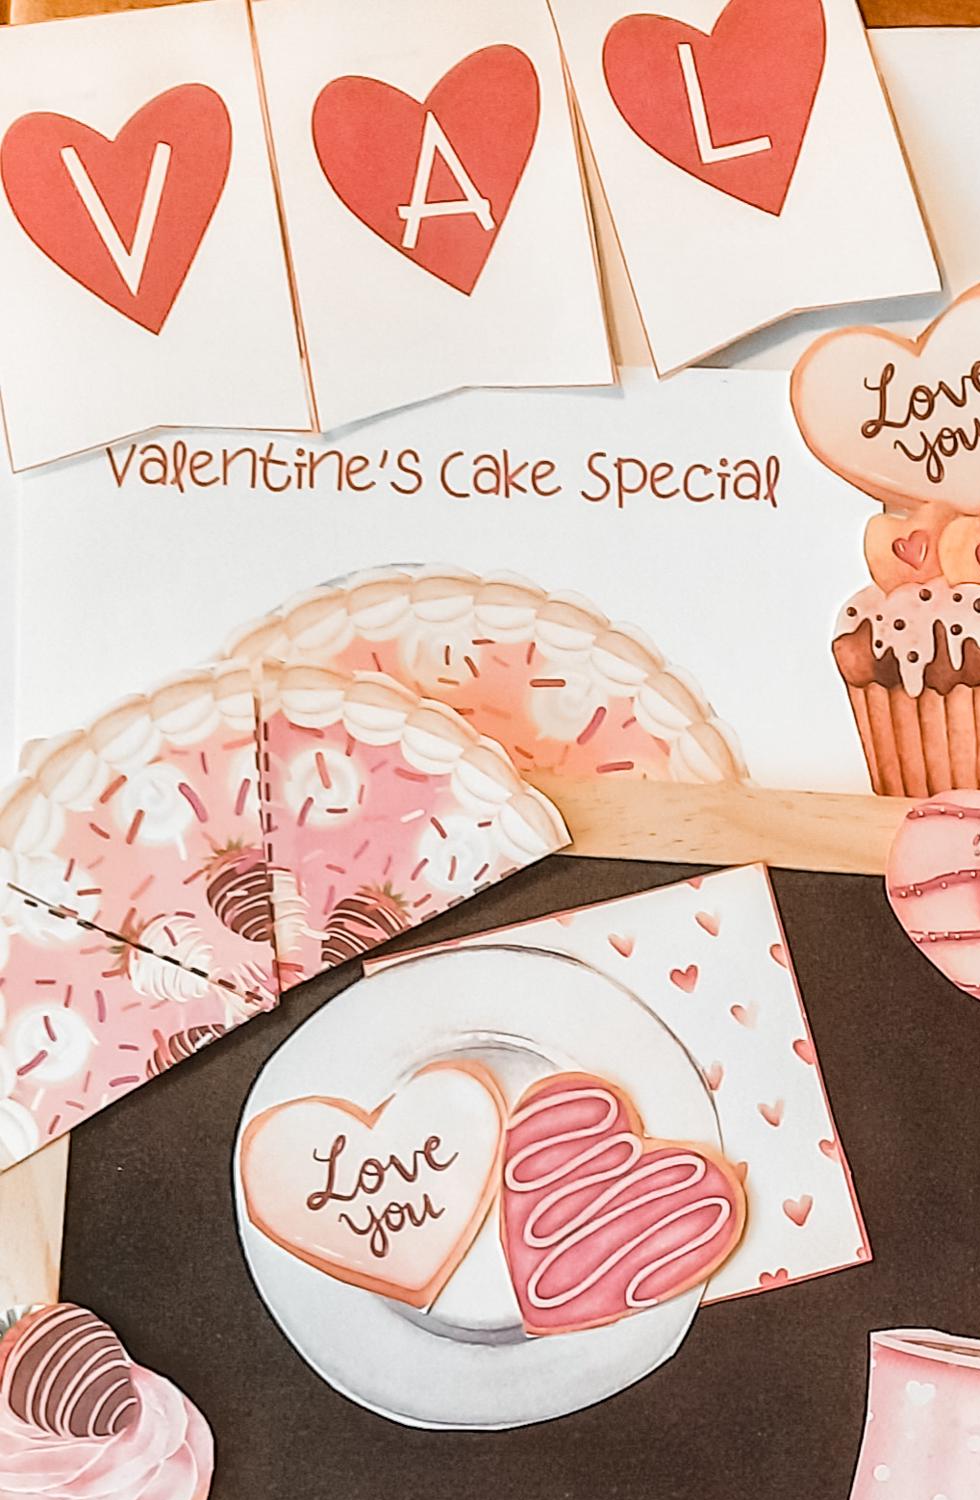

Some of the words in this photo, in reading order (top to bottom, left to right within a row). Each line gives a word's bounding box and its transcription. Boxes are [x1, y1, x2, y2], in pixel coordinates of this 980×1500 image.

[60, 142, 171, 296] V
[398, 112, 497, 250] A
[677, 43, 772, 164] L
[105, 440, 423, 495] Valentine's
[440, 449, 562, 499] Cake
[580, 451, 780, 509] Special
[306, 1134, 459, 1210] Love
[338, 1194, 446, 1258] you
